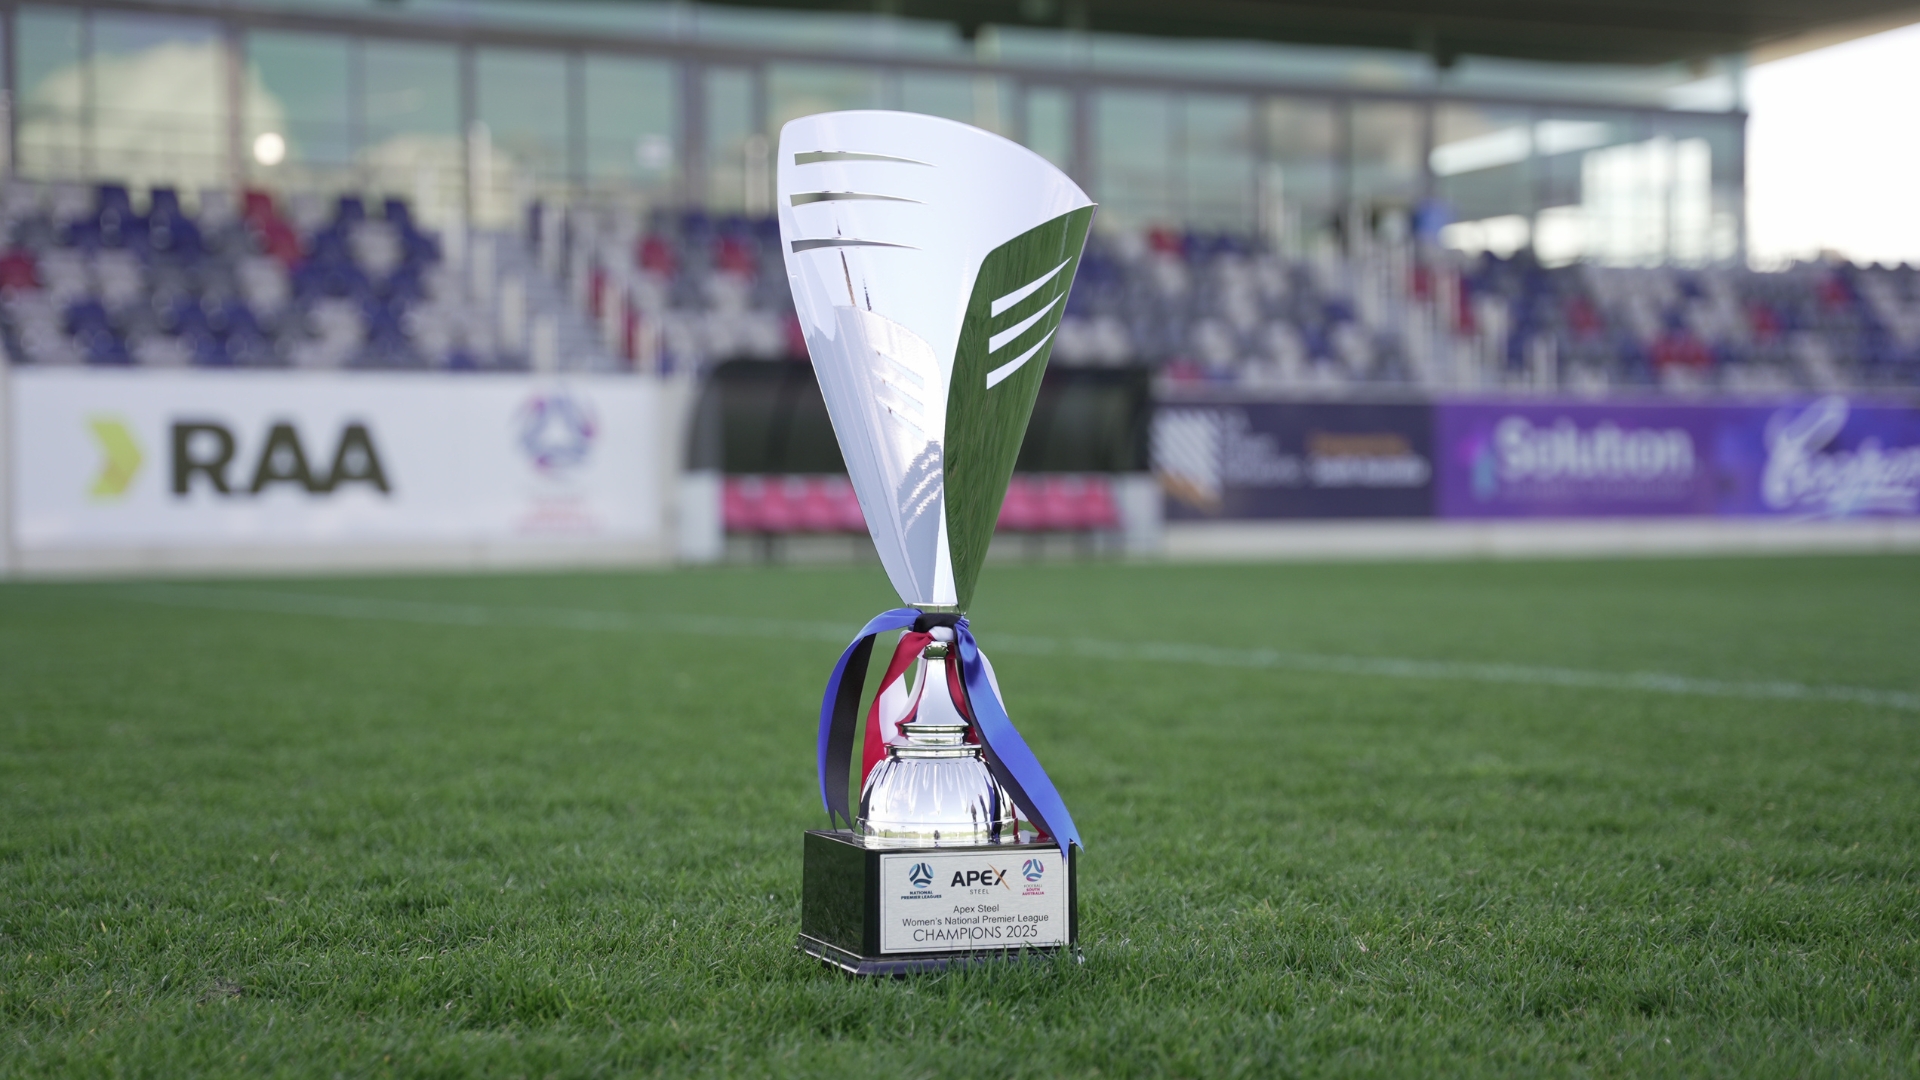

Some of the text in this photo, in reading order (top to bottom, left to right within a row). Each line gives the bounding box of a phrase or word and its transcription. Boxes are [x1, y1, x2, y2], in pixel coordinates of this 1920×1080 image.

[169, 421, 393, 496] RAA
[950, 863, 1010, 891] APEX
[953, 903, 1000, 915] Apex Steel
[902, 913, 1050, 927] Women's National Premier League
[913, 924, 1039, 942] CHAMPIONS 2025
